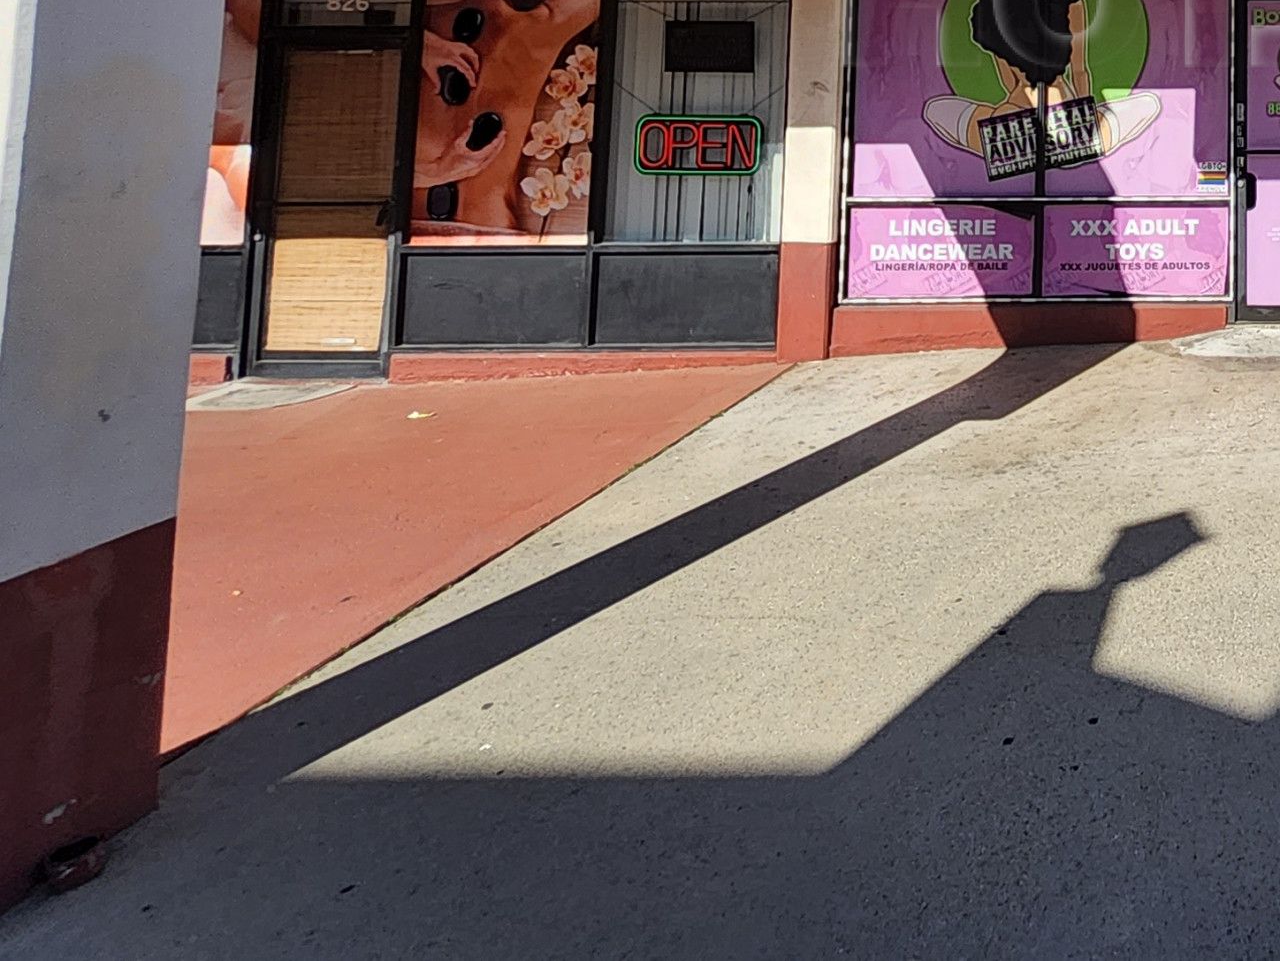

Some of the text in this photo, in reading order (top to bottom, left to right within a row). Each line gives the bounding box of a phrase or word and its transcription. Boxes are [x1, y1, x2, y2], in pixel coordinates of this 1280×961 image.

[640, 123, 757, 168] OPEN
[889, 219, 996, 236] LINGERIE
[1071, 219, 1199, 236] XXX ADULT
[870, 243, 1013, 261] DANCEWEAR
[1105, 243, 1165, 261] TOYS
[960, 262, 975, 271] DE
[977, 262, 1008, 271] BAILE
[1060, 262, 1082, 271] XXX
[1144, 262, 1159, 271] DE
[1161, 262, 1210, 271] ADULTOS
